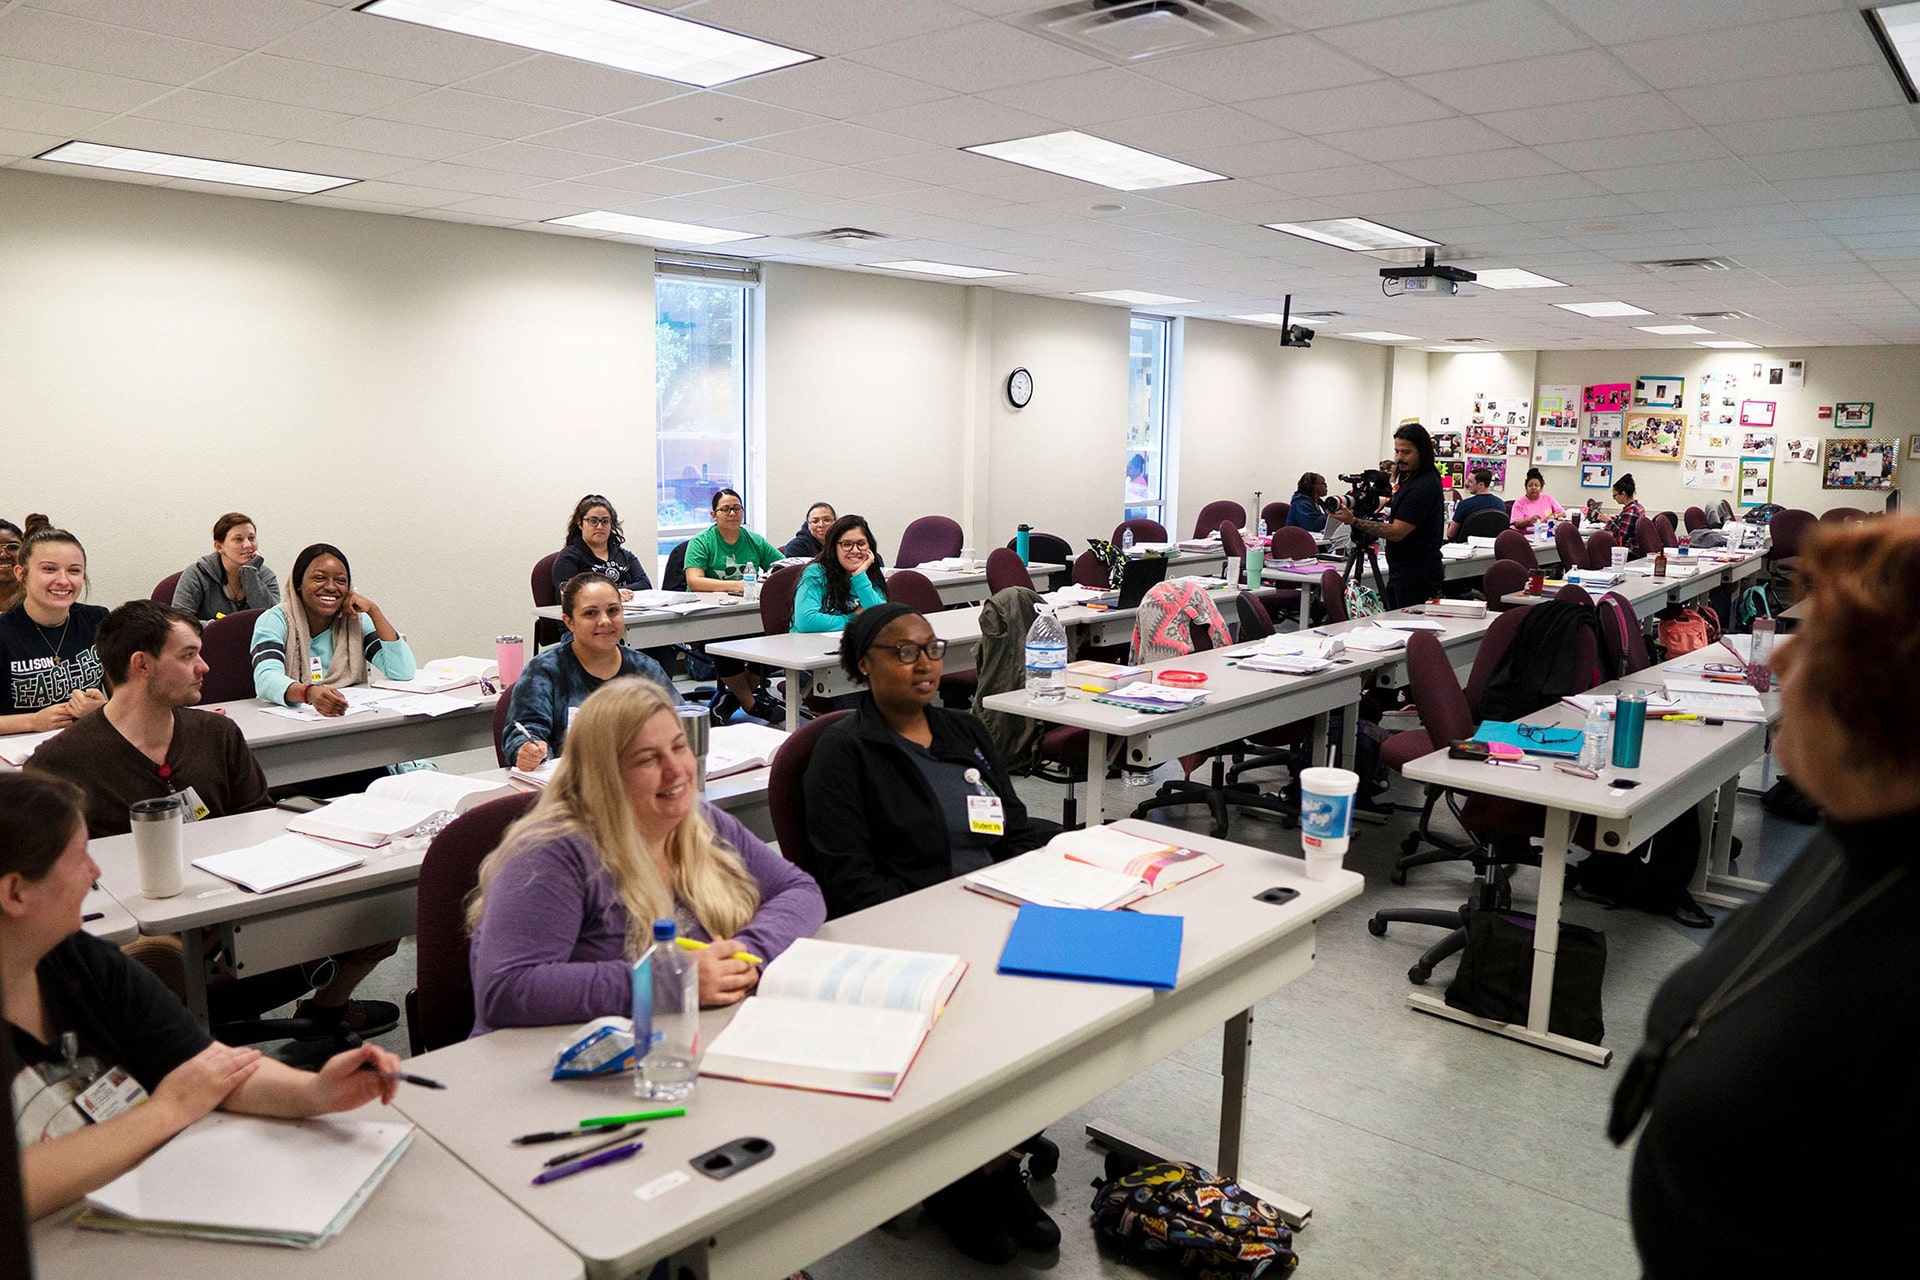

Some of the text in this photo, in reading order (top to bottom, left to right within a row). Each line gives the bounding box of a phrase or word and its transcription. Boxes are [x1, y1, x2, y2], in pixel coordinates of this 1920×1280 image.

[11, 656, 54, 672] ELLISON
[972, 821, 993, 830] Student
[1309, 813, 1330, 827] Pop
